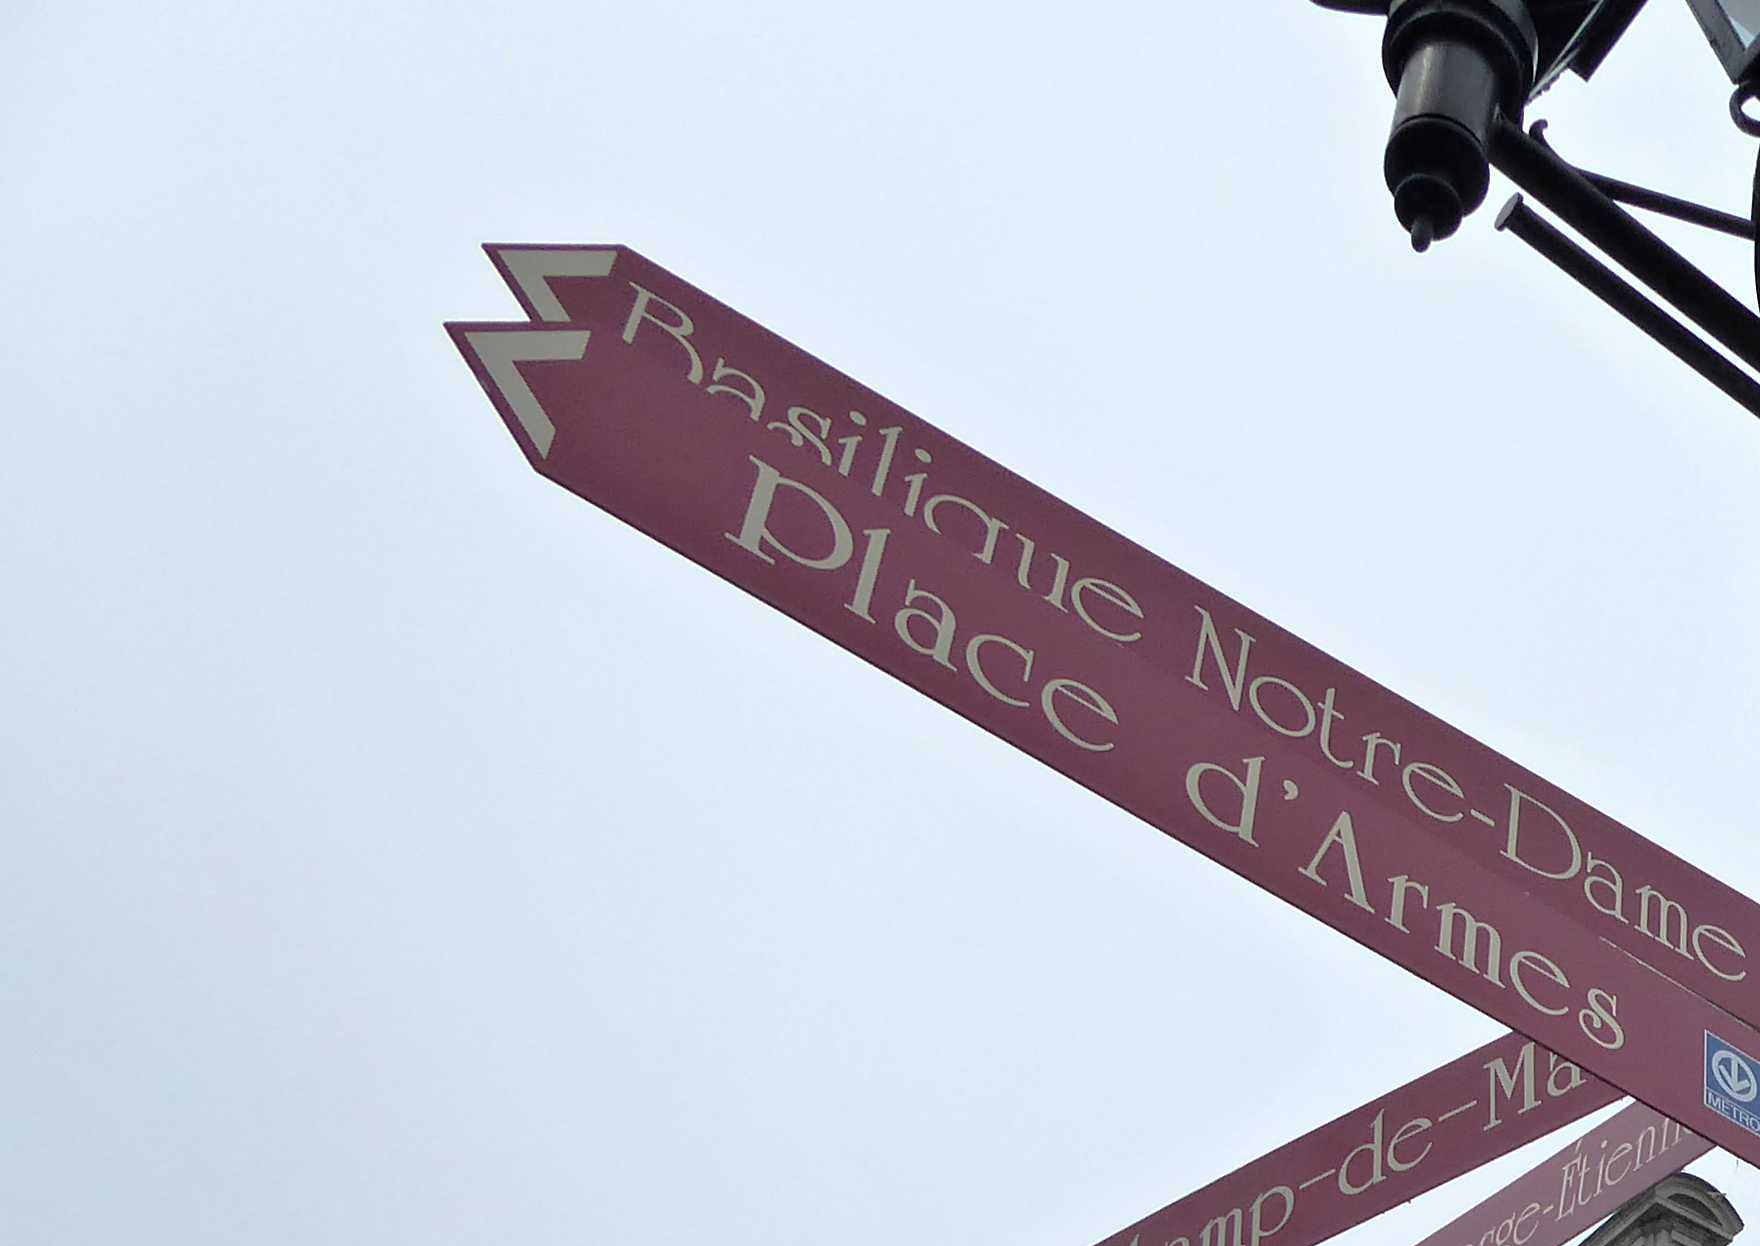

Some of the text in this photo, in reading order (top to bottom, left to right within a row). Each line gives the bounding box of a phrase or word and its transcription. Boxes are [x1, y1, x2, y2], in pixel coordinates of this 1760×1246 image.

[725, 455, 1625, 1050] Place d'Armes
[1186, 605, 1746, 982] Notre-Dame
[1708, 1092, 1760, 1131] METRO
